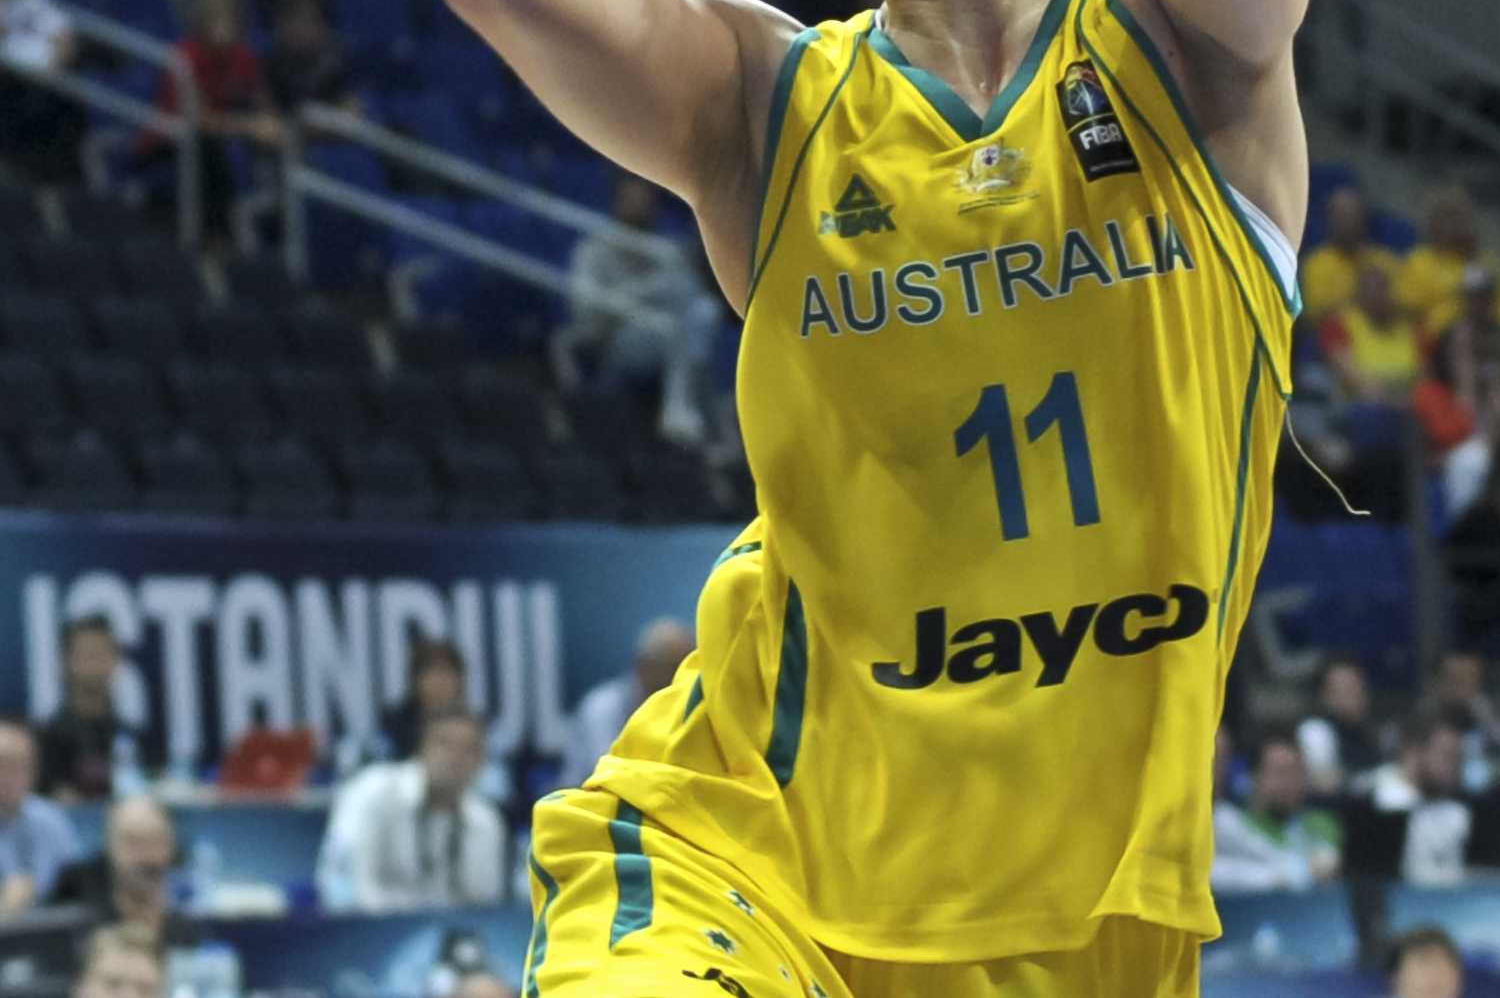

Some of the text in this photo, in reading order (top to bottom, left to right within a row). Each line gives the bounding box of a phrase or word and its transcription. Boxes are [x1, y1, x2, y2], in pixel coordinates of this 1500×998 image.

[800, 212, 1195, 338] AUSTRALIA
[953, 370, 1101, 542] 11
[871, 583, 1209, 690] Jayco
